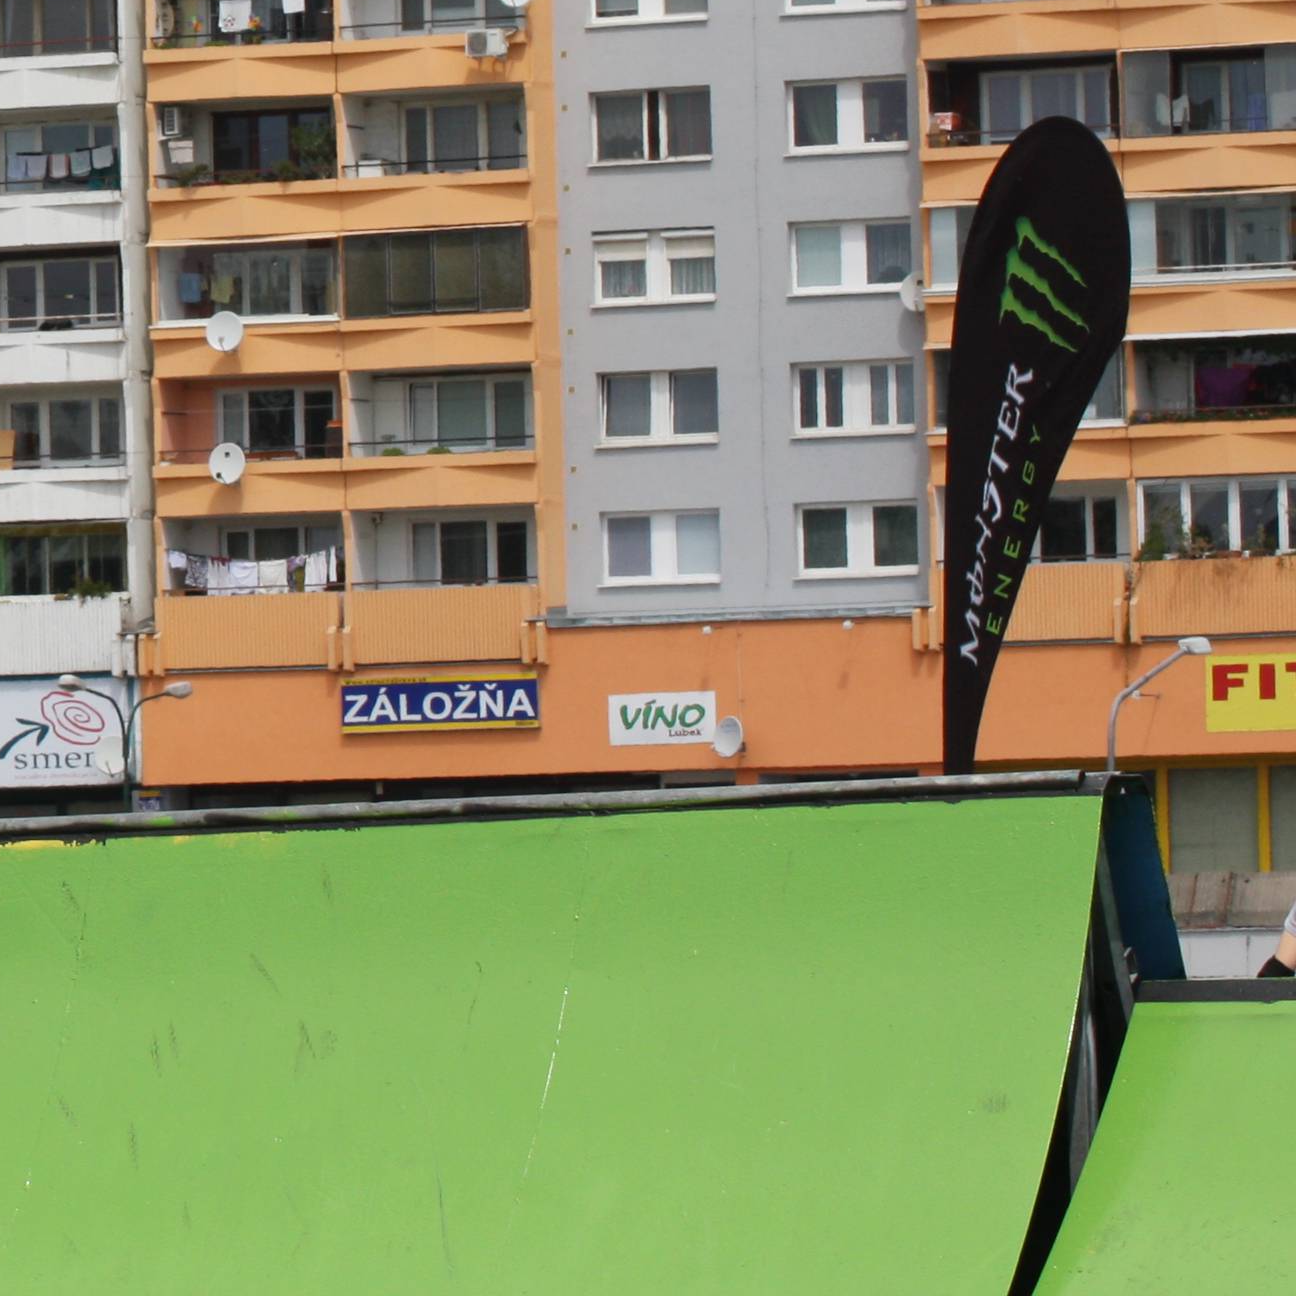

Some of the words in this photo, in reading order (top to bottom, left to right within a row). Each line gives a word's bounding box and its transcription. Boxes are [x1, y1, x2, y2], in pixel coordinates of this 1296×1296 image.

[960, 363, 1034, 666] MONSTER
[985, 423, 1041, 636] ENERGY
[344, 683, 535, 723] ZÁLOŽŇA
[620, 699, 706, 730] VÍNO
[13, 750, 95, 770] smer
